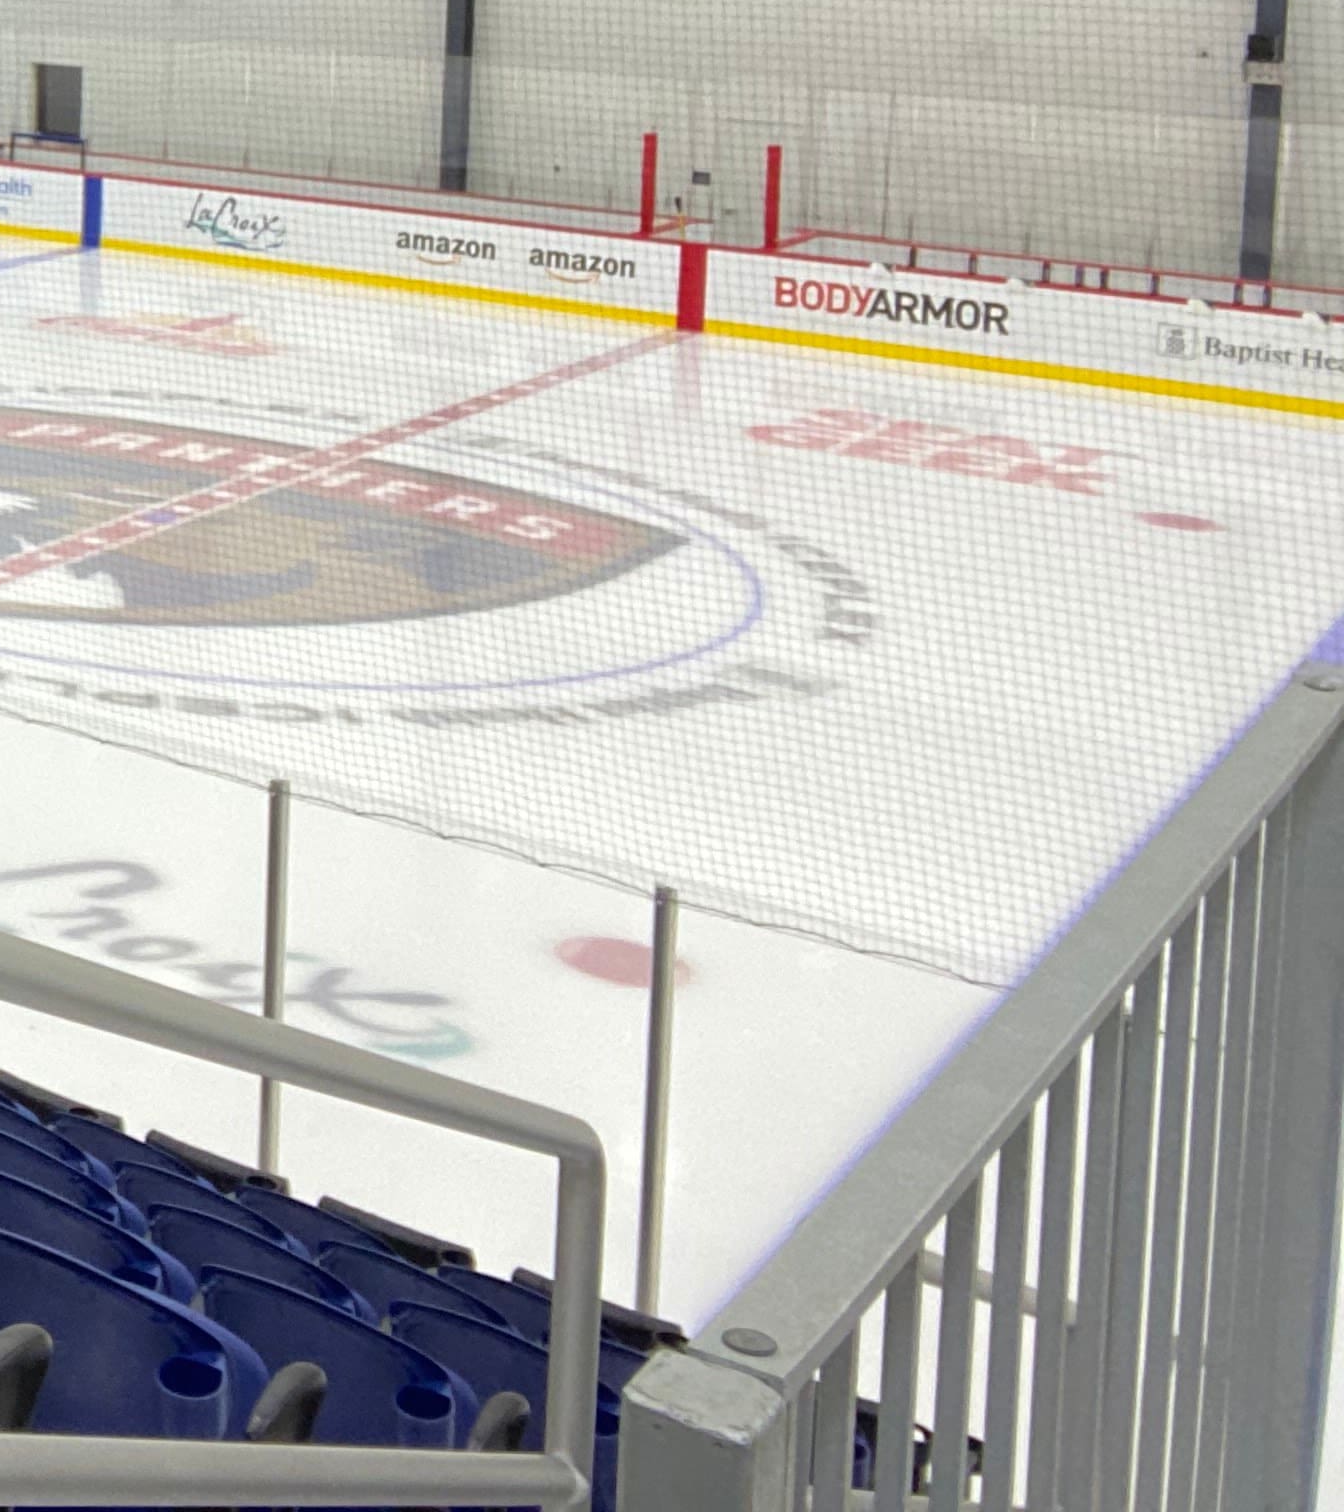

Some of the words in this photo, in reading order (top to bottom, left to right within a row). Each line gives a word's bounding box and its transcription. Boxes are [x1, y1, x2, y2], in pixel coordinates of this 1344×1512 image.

[396, 231, 497, 261] amazon
[529, 247, 636, 278] amazon
[774, 276, 1010, 336] BODYARMOR
[1204, 336, 1295, 365] Baptist
[9, 422, 574, 541] PANTHERS
